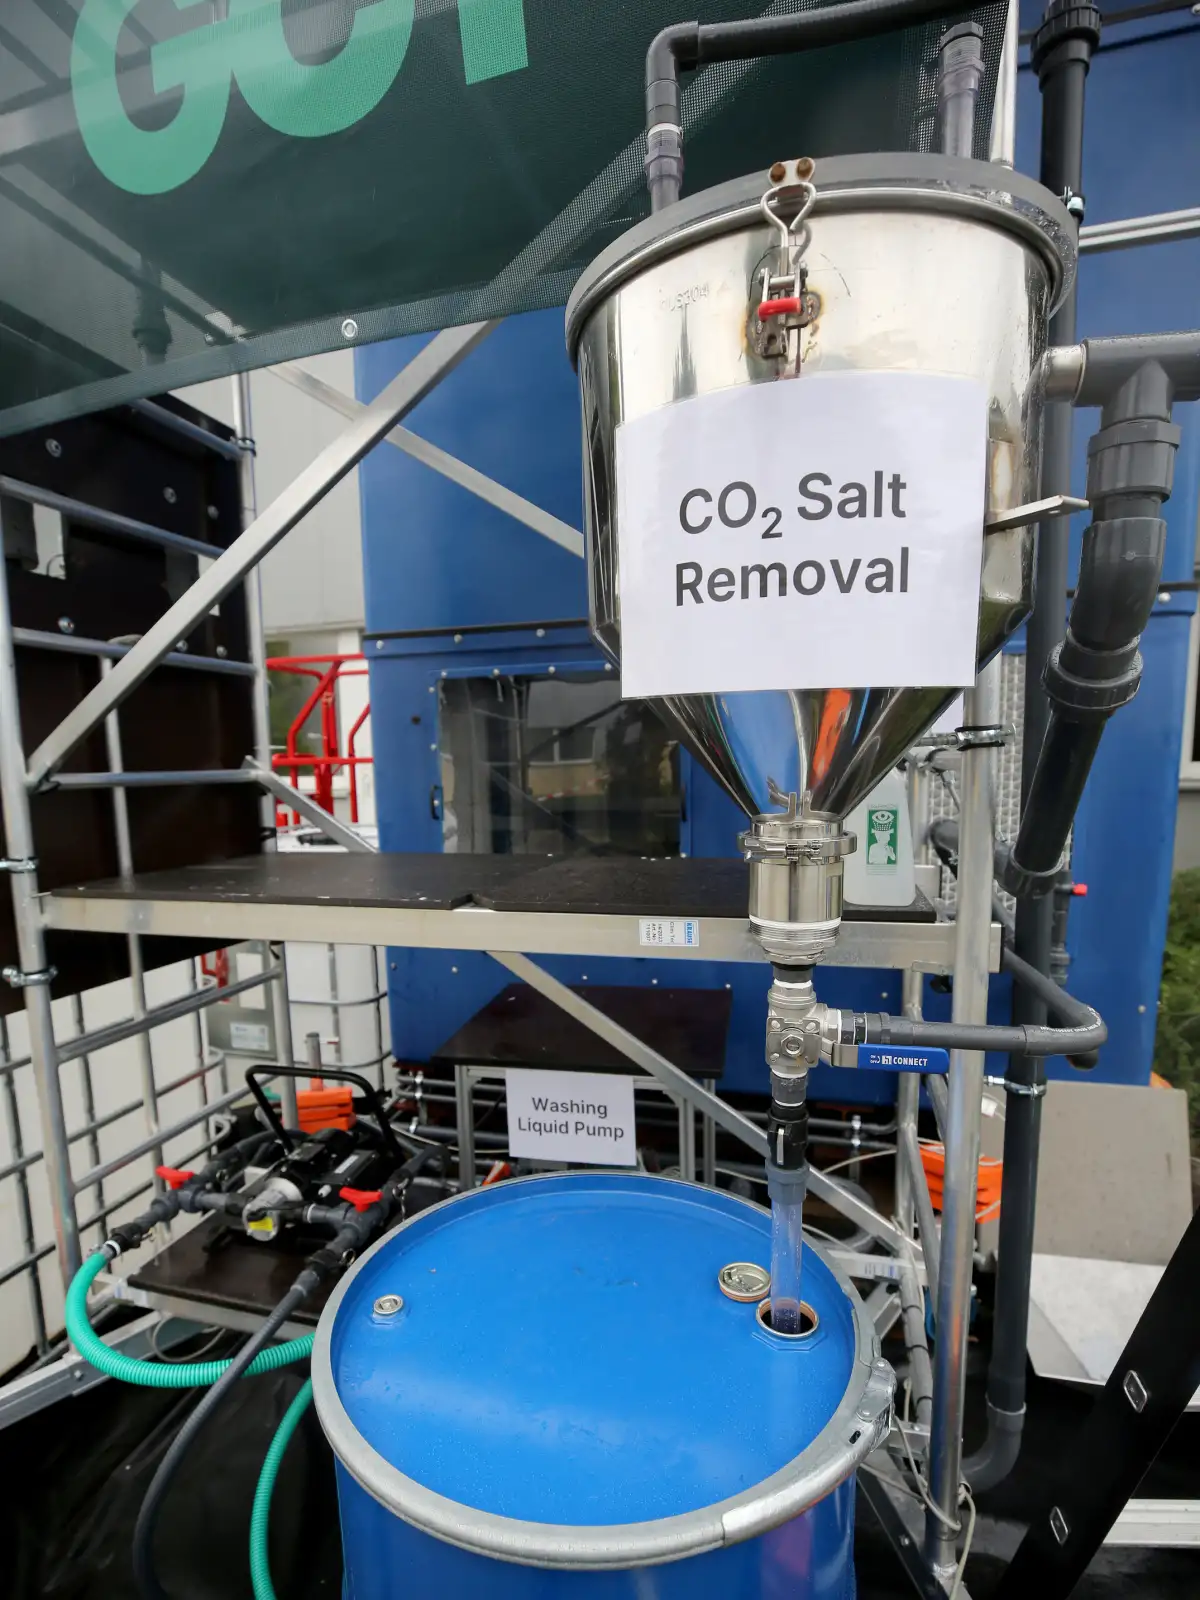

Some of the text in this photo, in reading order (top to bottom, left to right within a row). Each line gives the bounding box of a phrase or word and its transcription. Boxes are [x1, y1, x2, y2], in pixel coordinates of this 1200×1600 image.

[797, 470, 907, 521] Salt
[676, 546, 910, 606] Removal
[893, 1056, 928, 1067] CONNECT
[531, 1097, 608, 1119] Washing
[518, 1117, 624, 1141] Liquid Pump
